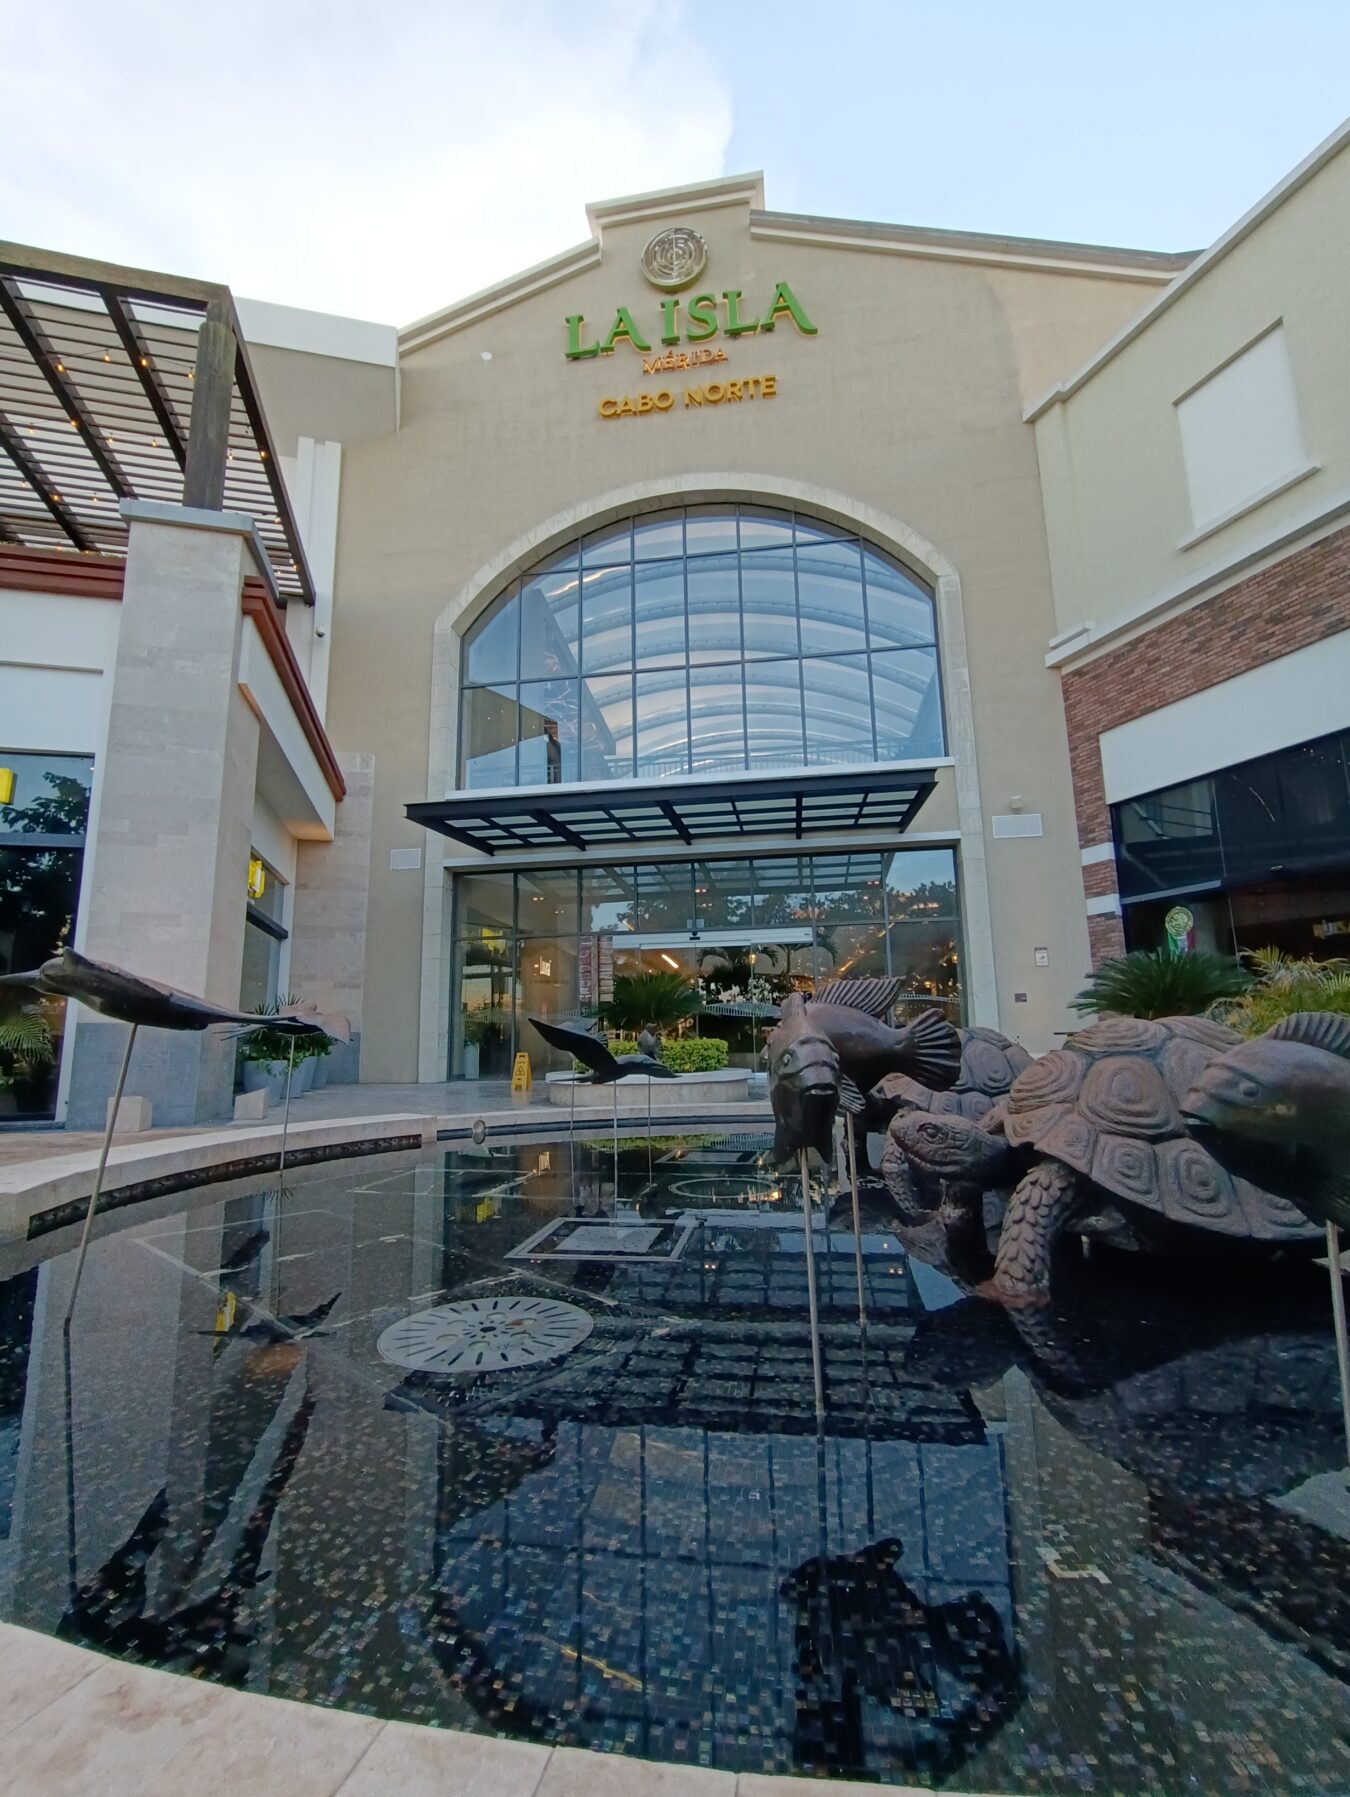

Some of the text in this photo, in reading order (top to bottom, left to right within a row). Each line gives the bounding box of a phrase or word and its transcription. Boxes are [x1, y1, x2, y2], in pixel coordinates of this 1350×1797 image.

[565, 281, 818, 360] LA ISLA
[643, 350, 728, 374] MÉRIDA
[599, 375, 777, 418] CABO NORTE
